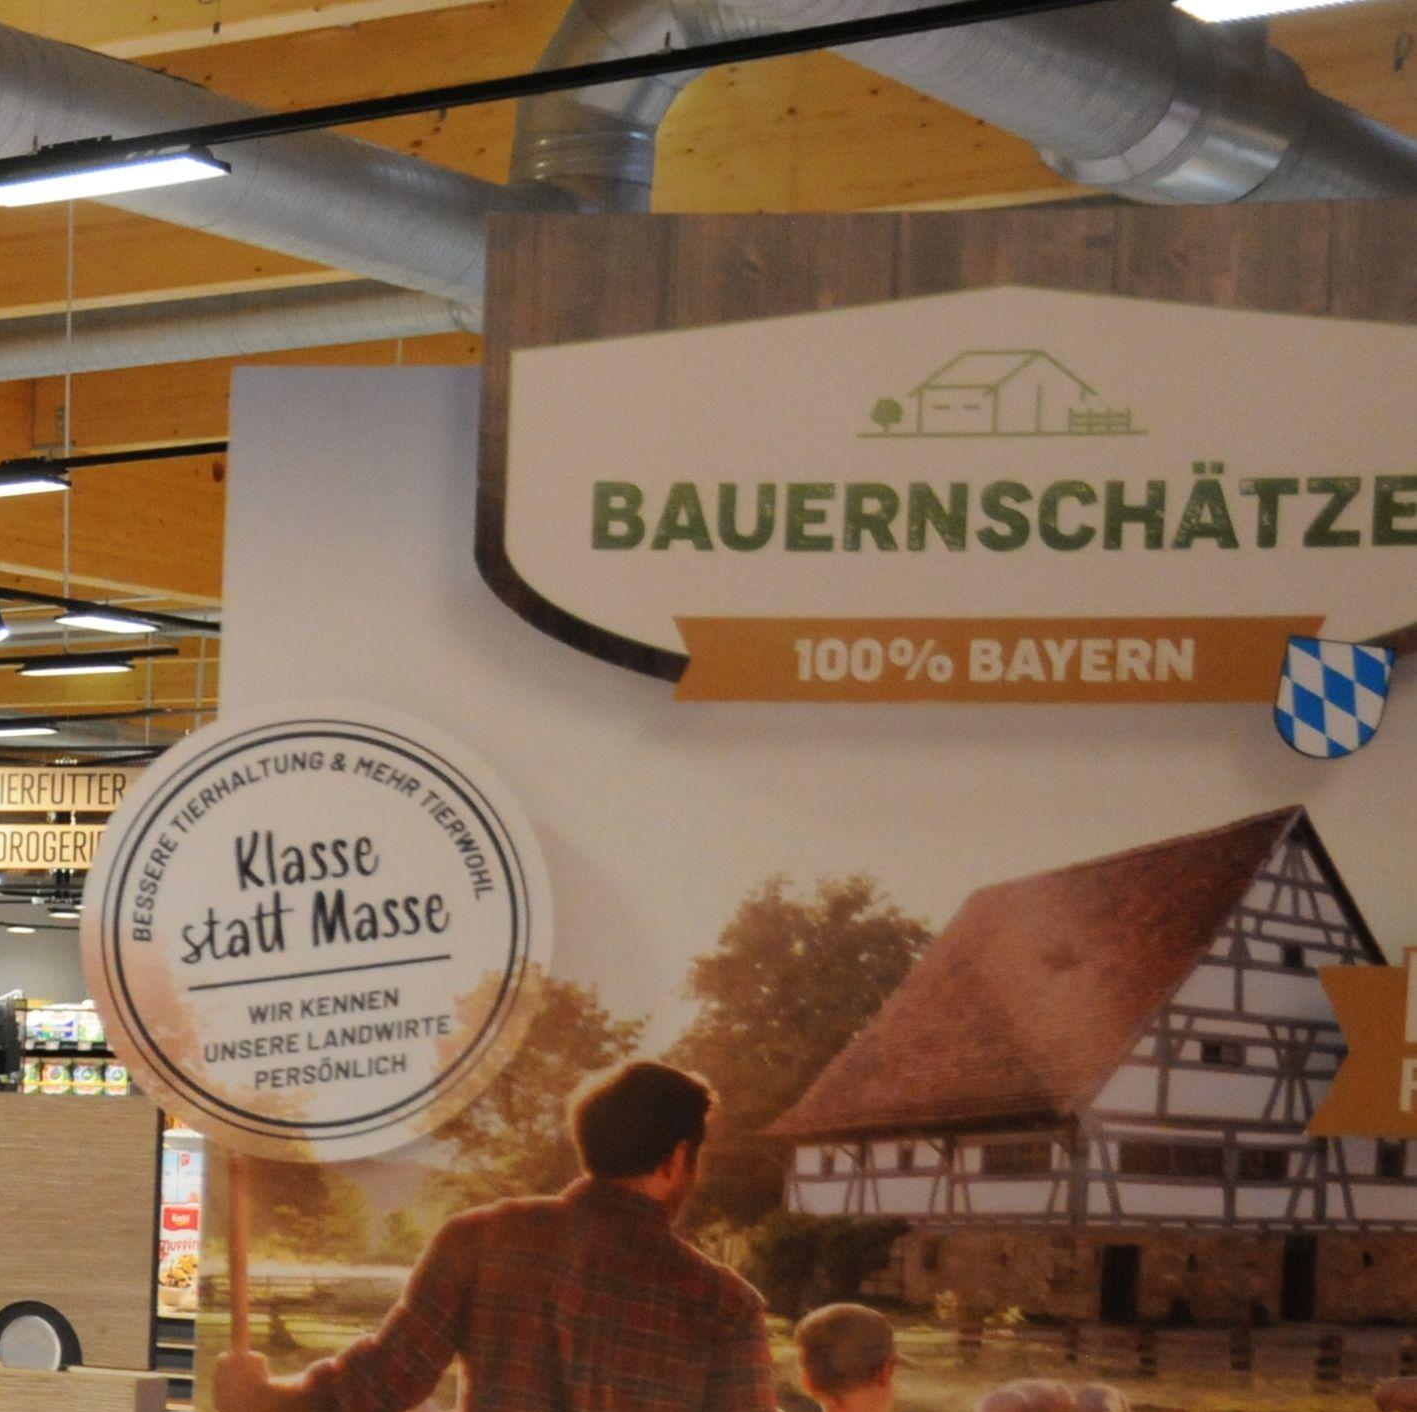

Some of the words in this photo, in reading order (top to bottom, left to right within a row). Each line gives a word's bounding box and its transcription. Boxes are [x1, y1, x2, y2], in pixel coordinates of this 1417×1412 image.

[590, 461, 1417, 552] BAUERNSCHÄTZE
[794, 635, 954, 683] 100%
[969, 636, 1194, 683] BAYERN
[131, 832, 177, 943] BESSERE
[171, 750, 325, 835] TIERHALTUNG
[330, 751, 347, 773] &
[352, 755, 422, 798] MEHR
[420, 789, 496, 901] TIERWOHL
[233, 829, 380, 891] Klasse
[180, 891, 295, 965] statt
[311, 888, 452, 950] Masse
[248, 1000, 293, 1025] WIR
[299, 988, 400, 1021] KENNEN
[203, 1031, 300, 1064] UNSERE
[306, 1014, 452, 1052] LANDWIRTE
[254, 1052, 408, 1090] PERSÖNLICH
